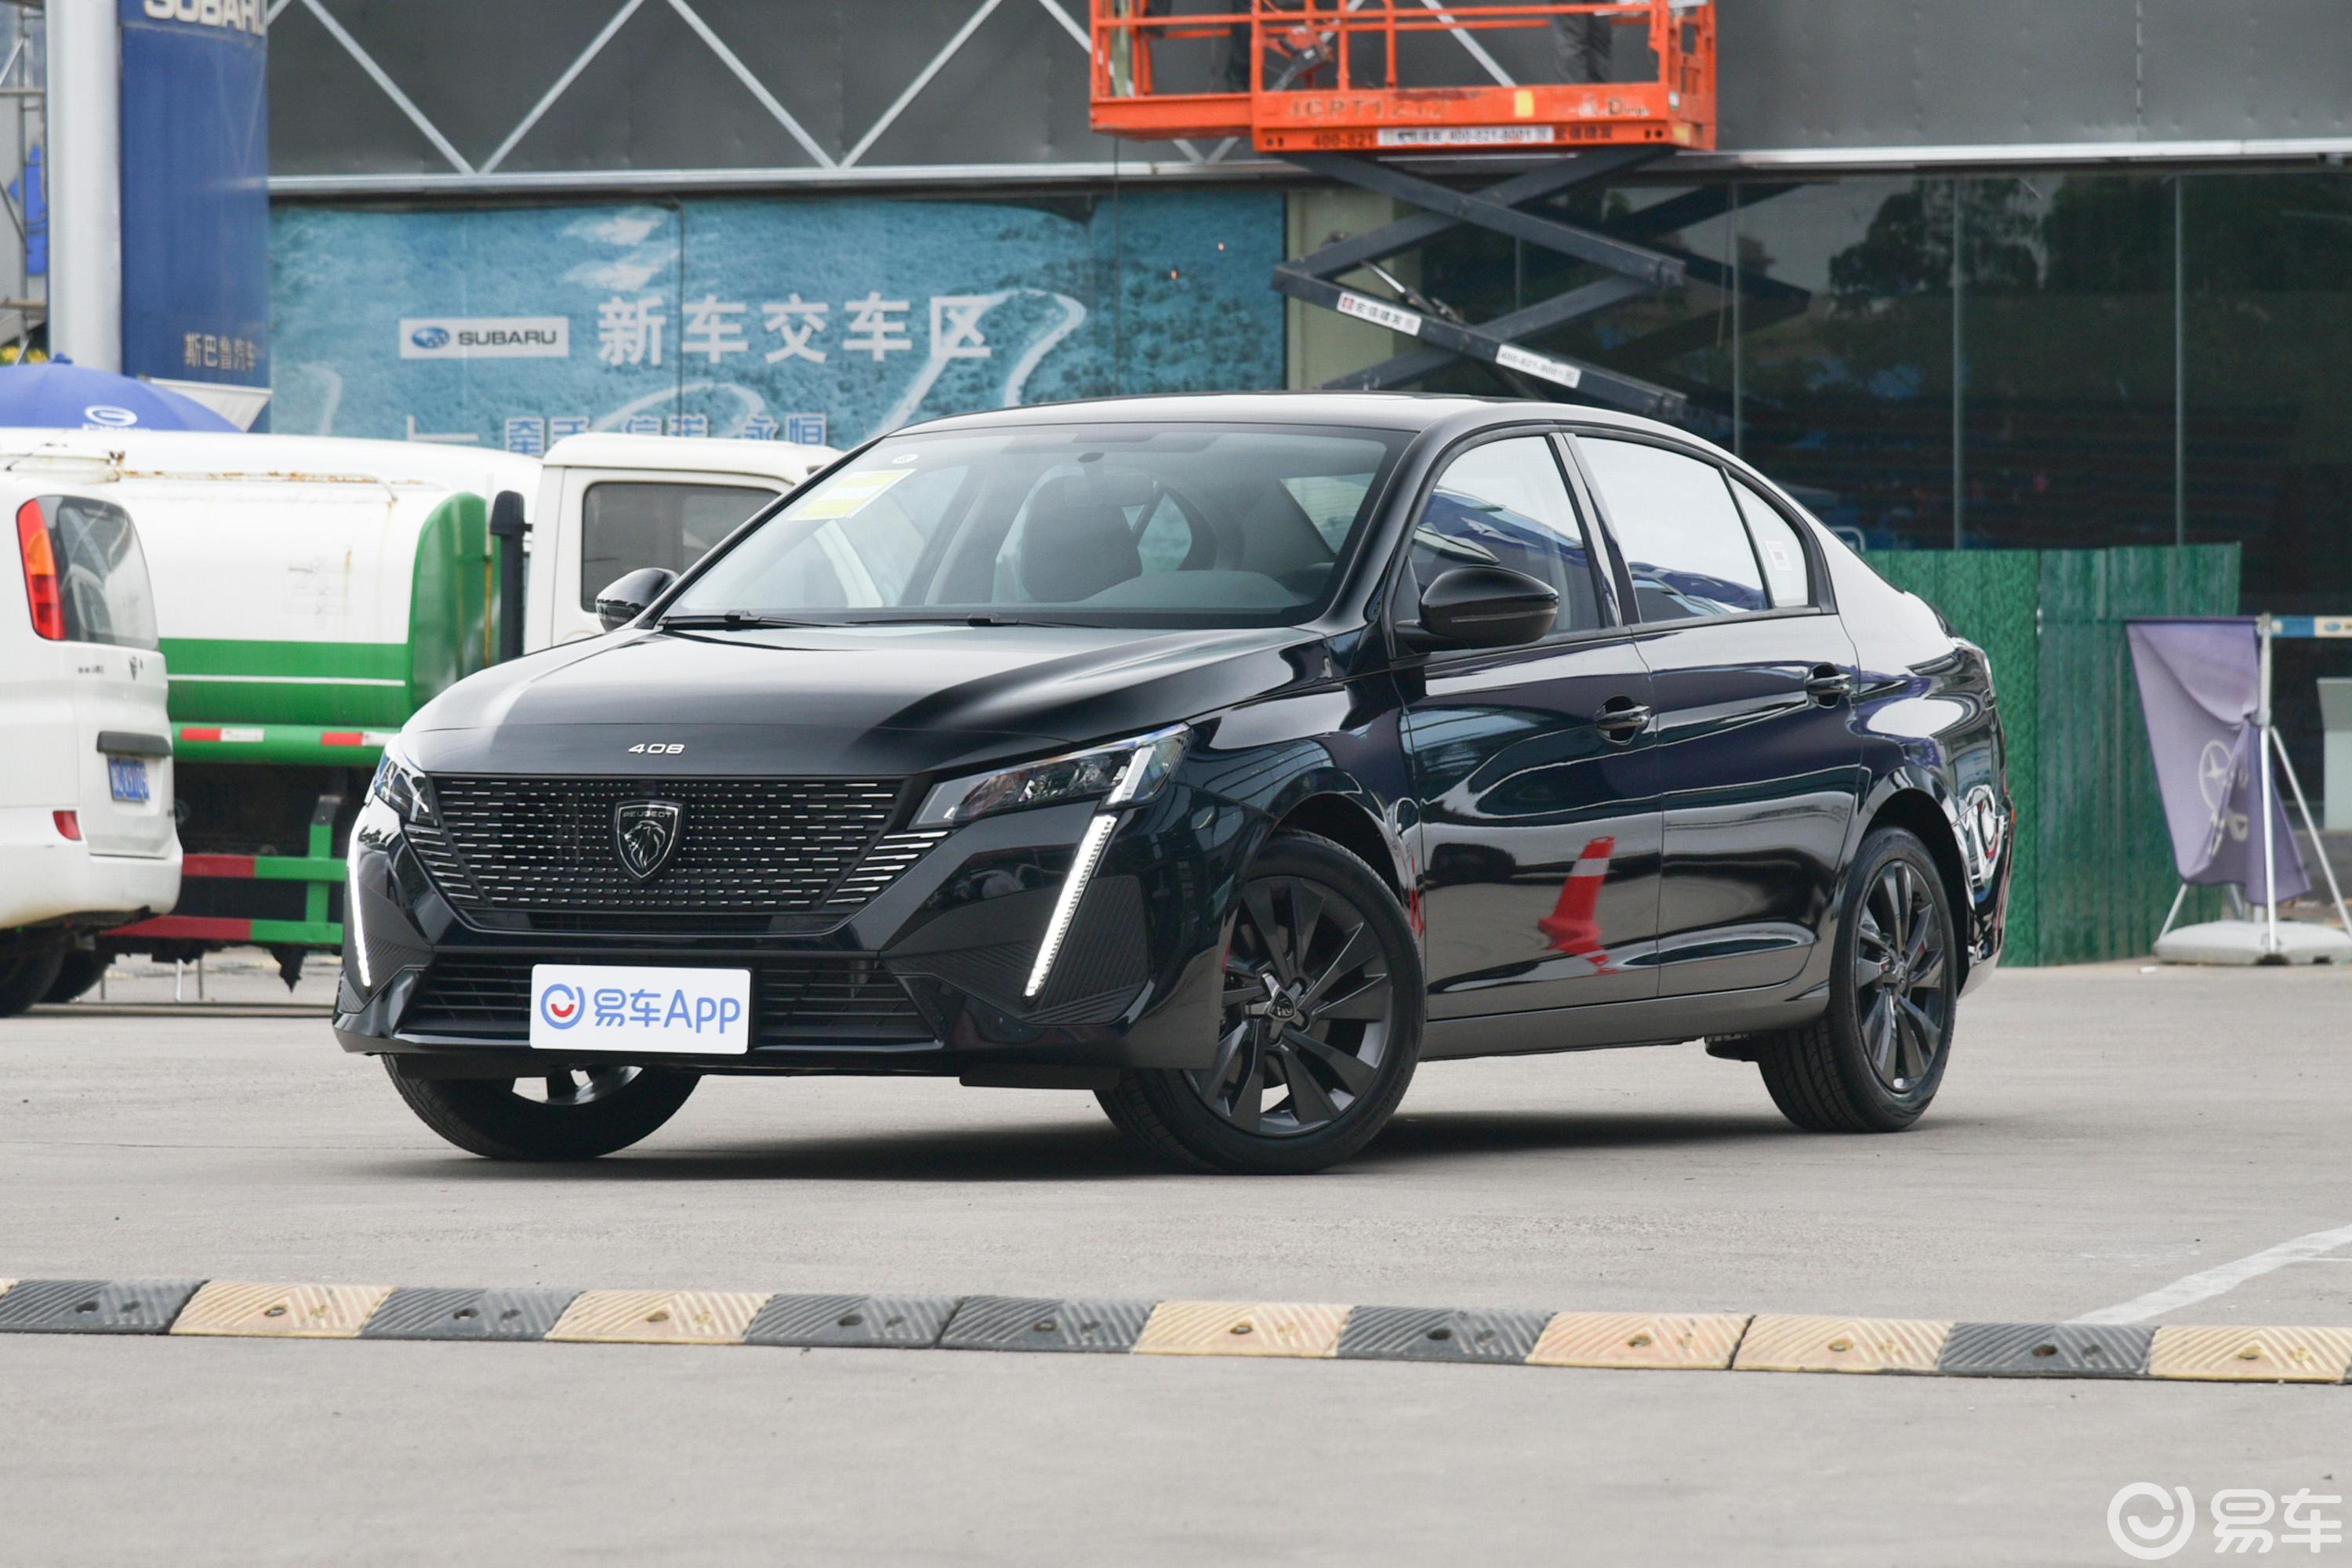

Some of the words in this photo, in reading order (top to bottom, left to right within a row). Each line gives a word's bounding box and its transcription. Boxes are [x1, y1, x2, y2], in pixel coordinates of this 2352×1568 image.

[597, 292, 991, 366] 新车交车区
[458, 330, 557, 345] SUBARU
[628, 744, 684, 754] 408
[623, 810, 672, 818] PEUGEOT
[593, 988, 741, 1034] 易车App
